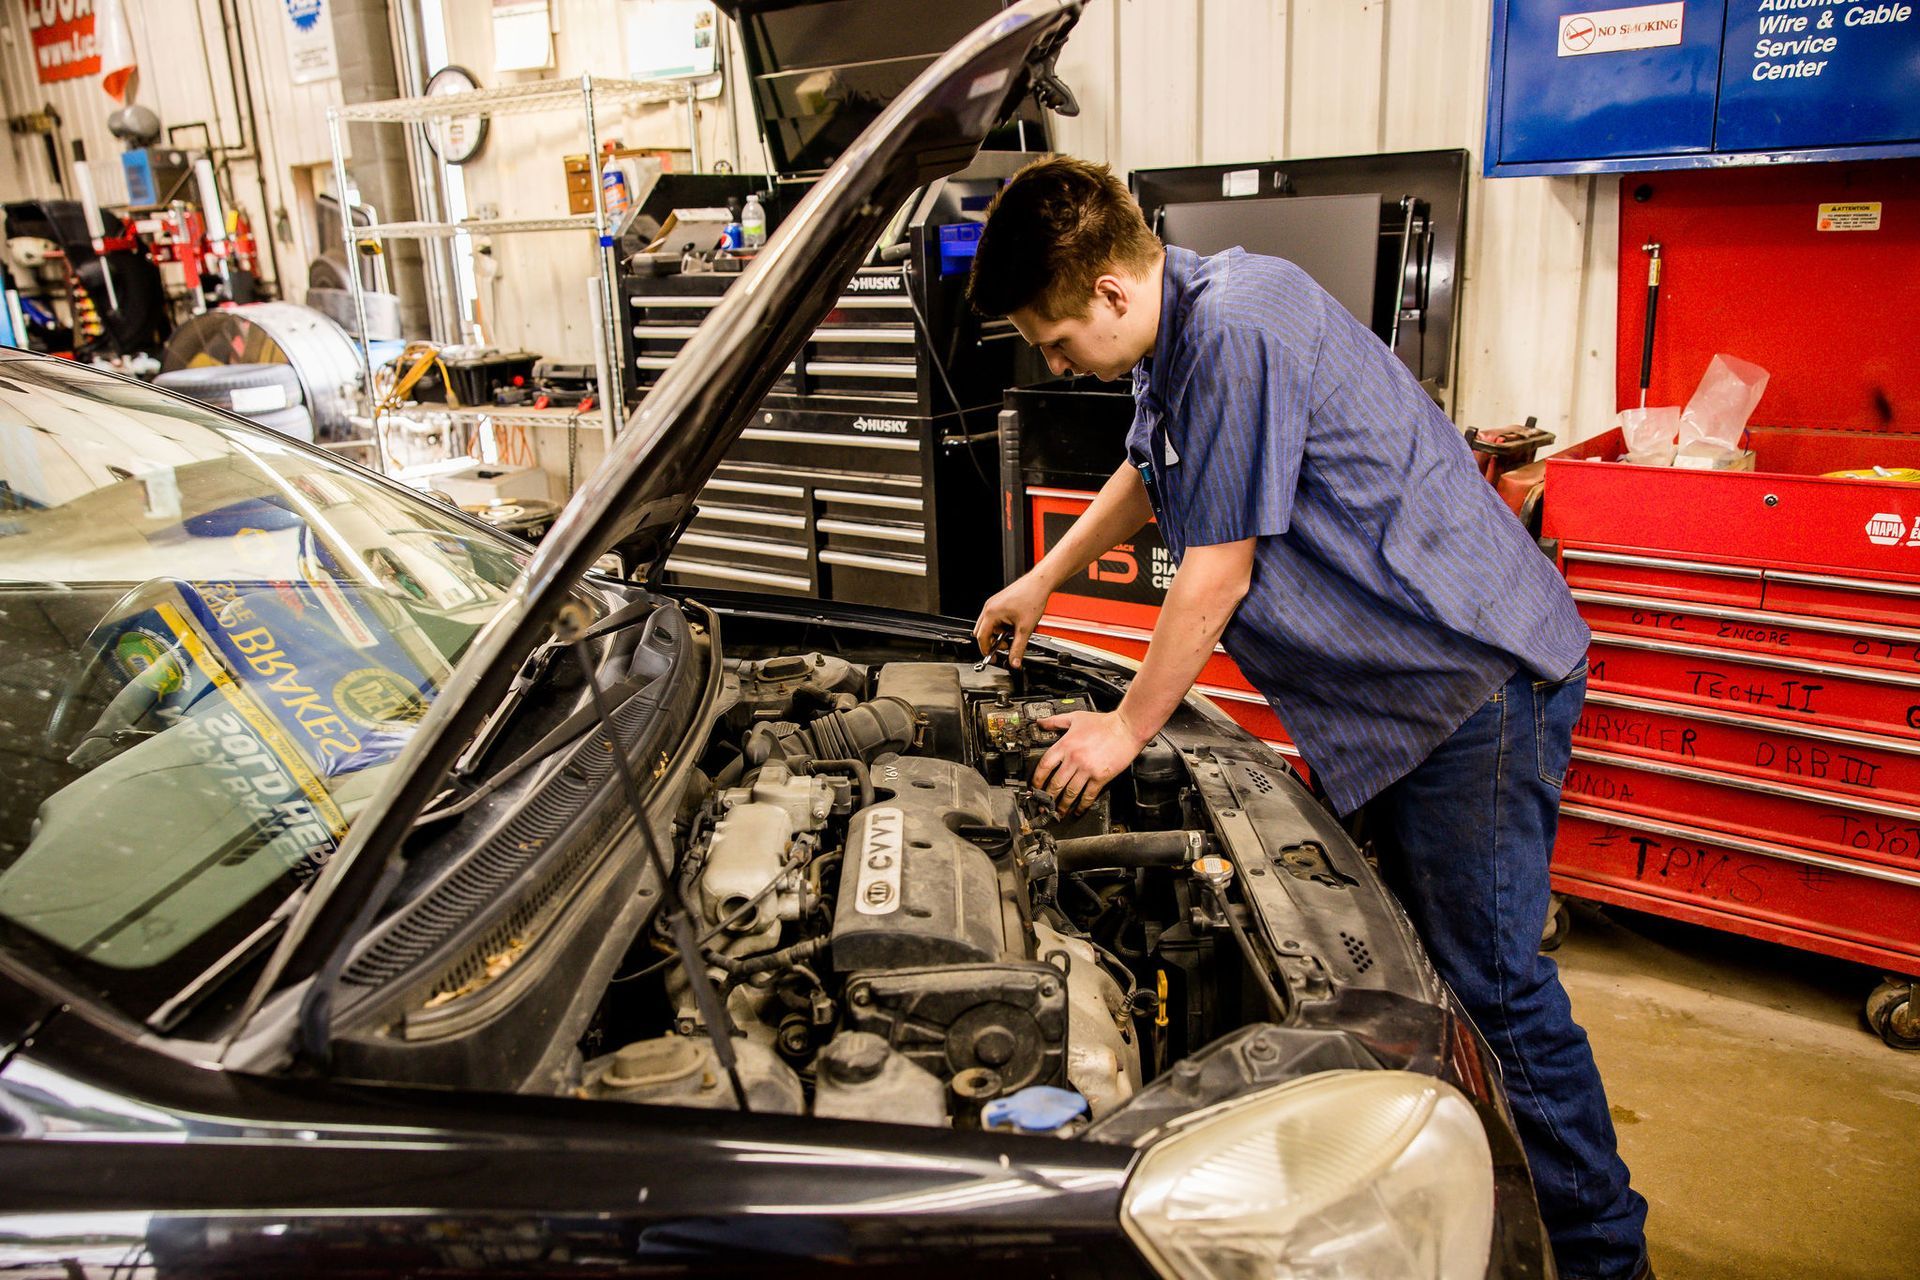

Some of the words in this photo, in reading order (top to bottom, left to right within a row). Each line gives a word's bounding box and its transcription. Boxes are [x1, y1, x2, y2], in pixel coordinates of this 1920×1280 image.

[1598, 25, 1617, 37] NO
[1620, 18, 1678, 35] SMOKING
[1759, 14, 1808, 35] Wire
[1816, 10, 1835, 30] &
[1844, 3, 1912, 27] Cable
[1753, 35, 1838, 59] Service
[1752, 60, 1828, 82] Center
[859, 276, 901, 290] HUSKY
[867, 418, 908, 433] HUSKY
[1152, 547, 1173, 562] IN
[1632, 611, 1685, 631] OTC
[884, 765, 899, 782] 16V
[1755, 742, 1831, 778] DRB
[1839, 755, 1882, 788] III
[868, 813, 896, 871] CVVT
